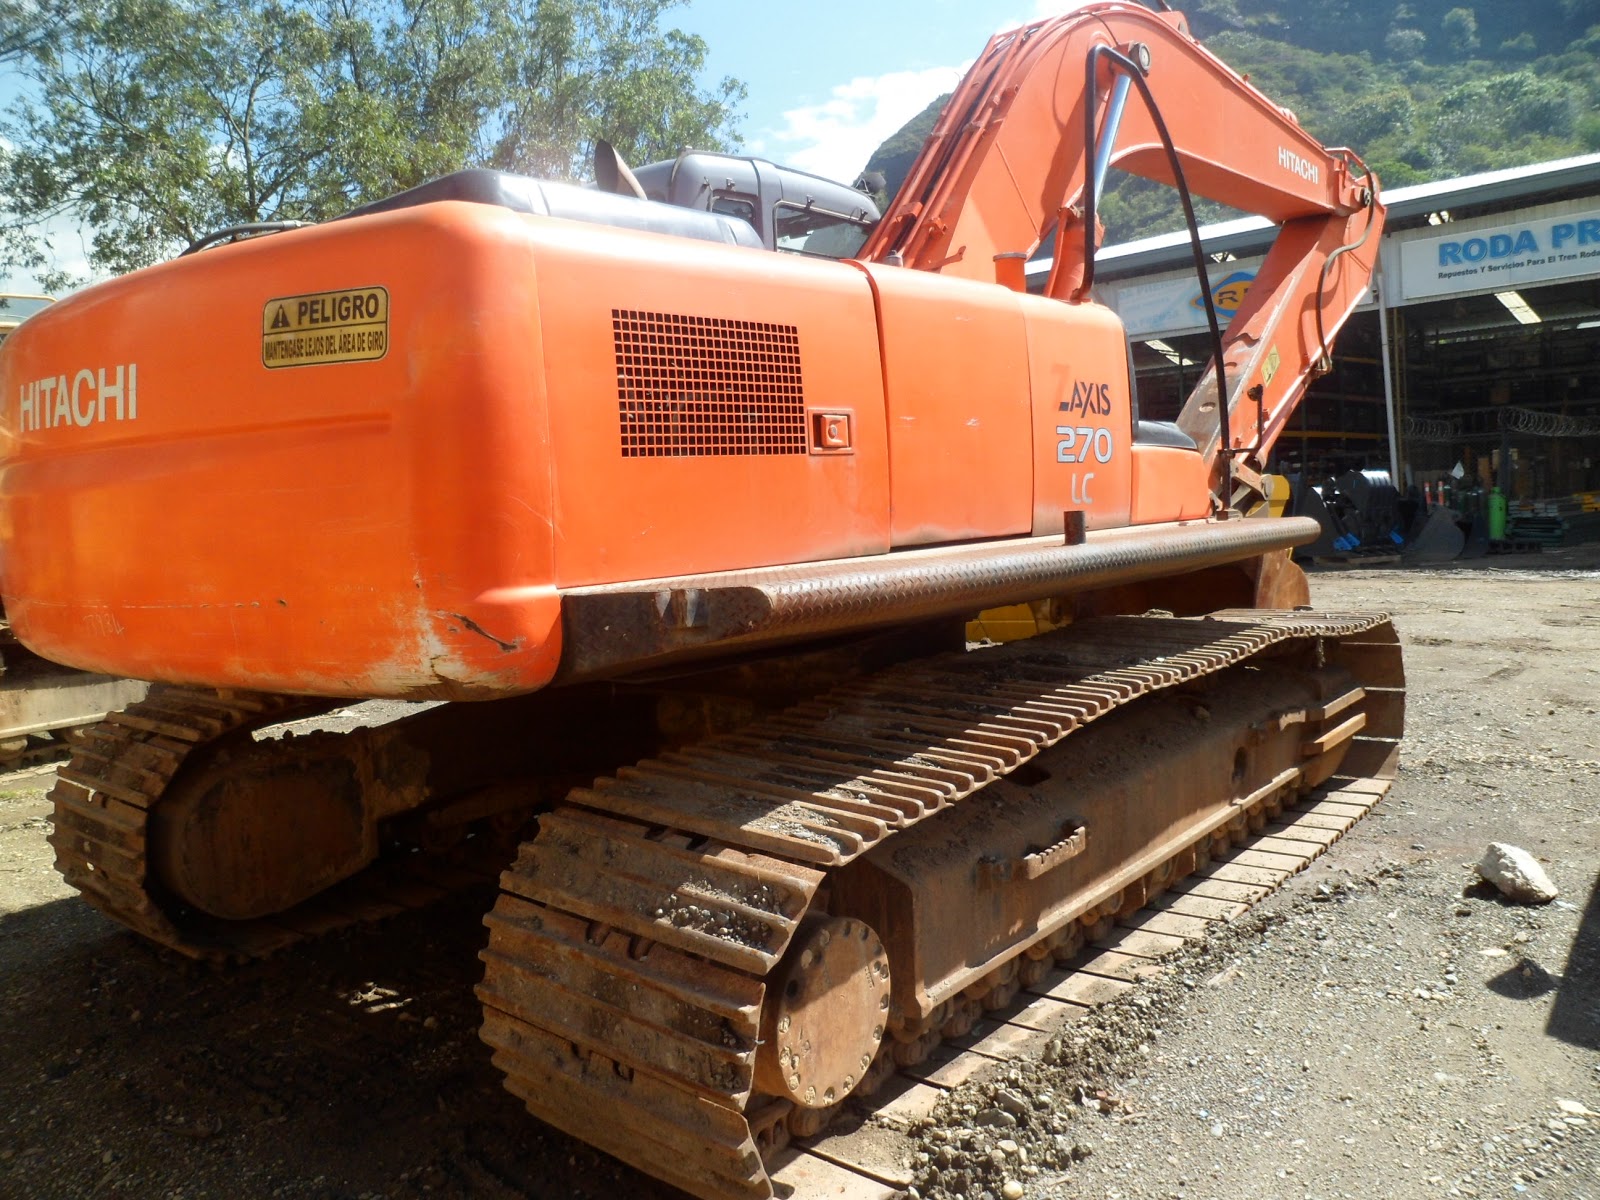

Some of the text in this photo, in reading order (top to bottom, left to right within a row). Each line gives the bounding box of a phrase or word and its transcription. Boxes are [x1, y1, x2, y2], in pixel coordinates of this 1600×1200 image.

[1278, 144, 1318, 185] HITACHI
[1438, 230, 1540, 267] RODA
[1438, 268, 1478, 279] Repuestos
[1480, 265, 1486, 274] Y
[1488, 261, 1525, 273] Servicios
[1527, 255, 1546, 267] Para
[1548, 255, 1556, 264] El
[1559, 252, 1578, 262] Tren
[297, 293, 380, 325] PELIGRO
[264, 329, 384, 361] MANTENGASE LEJOS DEL ÁREA DE GIRO
[20, 363, 137, 433] HITACHI
[1056, 425, 1113, 464] 270
[1071, 472, 1095, 505] LC
